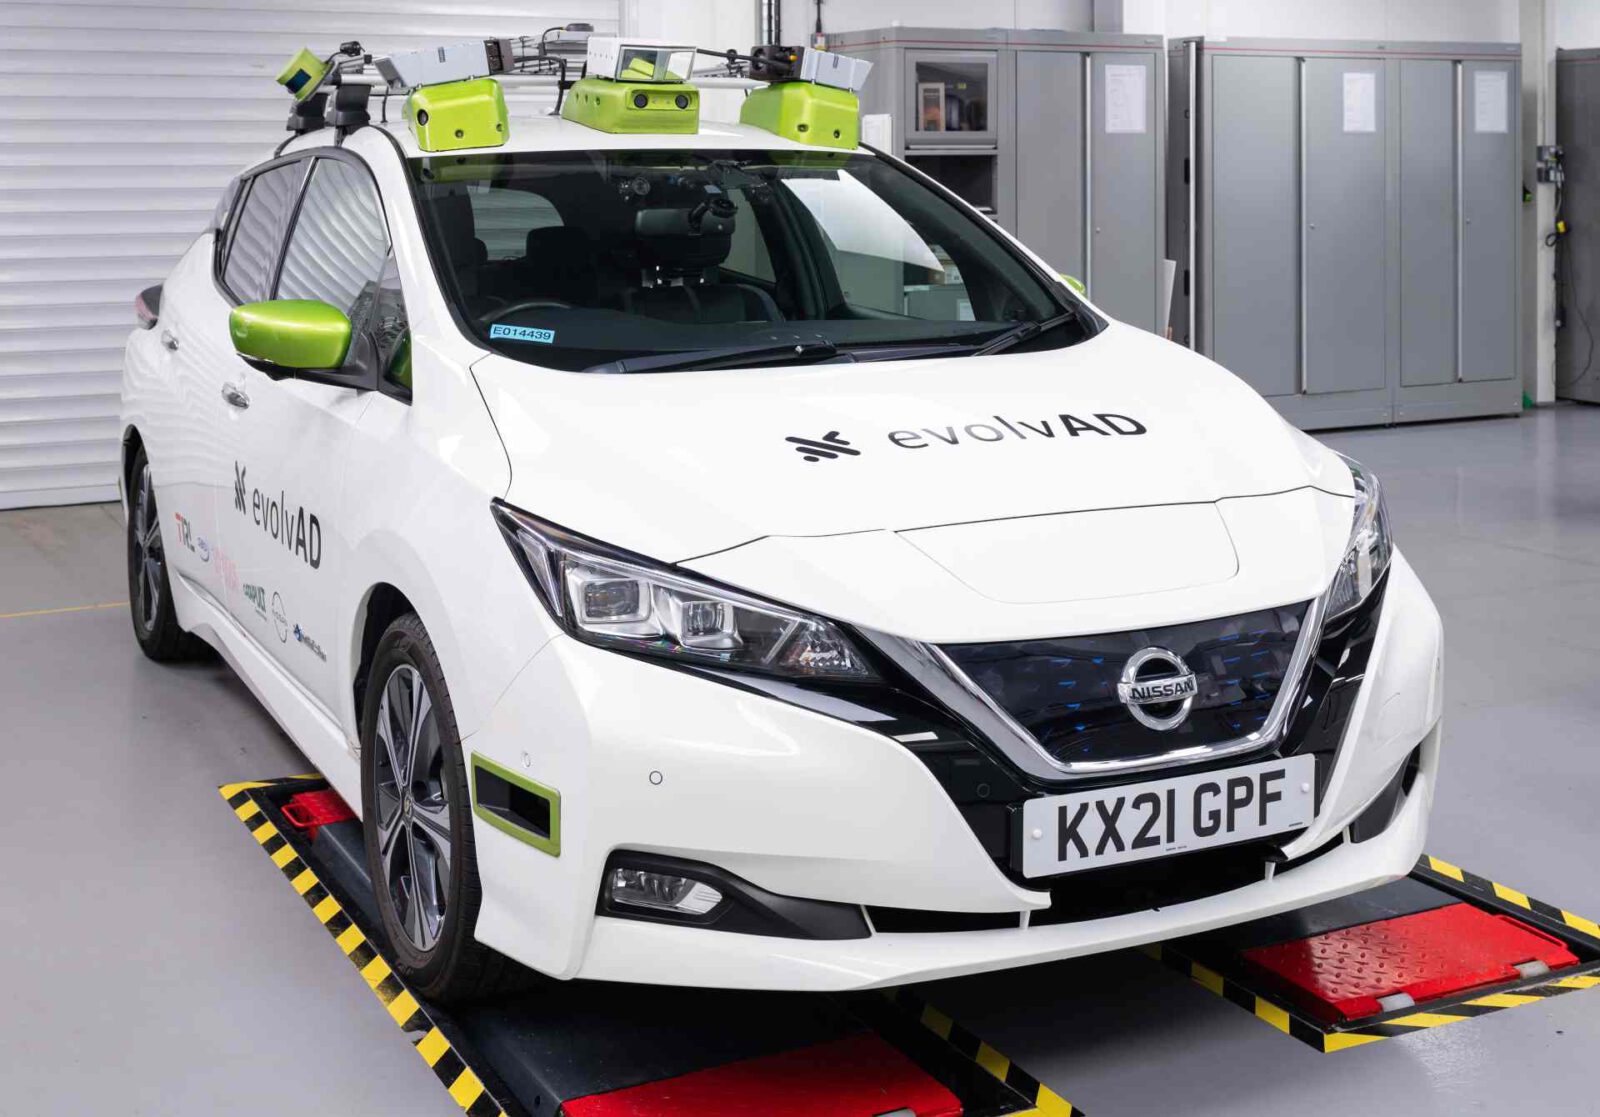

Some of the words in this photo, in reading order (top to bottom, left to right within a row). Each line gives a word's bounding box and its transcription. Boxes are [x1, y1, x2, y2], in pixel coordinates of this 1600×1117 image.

[493, 326, 551, 340] E014439
[887, 413, 1148, 449] evolvAD
[253, 487, 322, 570] evolvAD
[1130, 678, 1195, 700] NISSAN
[1057, 788, 1176, 862] KX21
[1192, 768, 1286, 838] GPF
